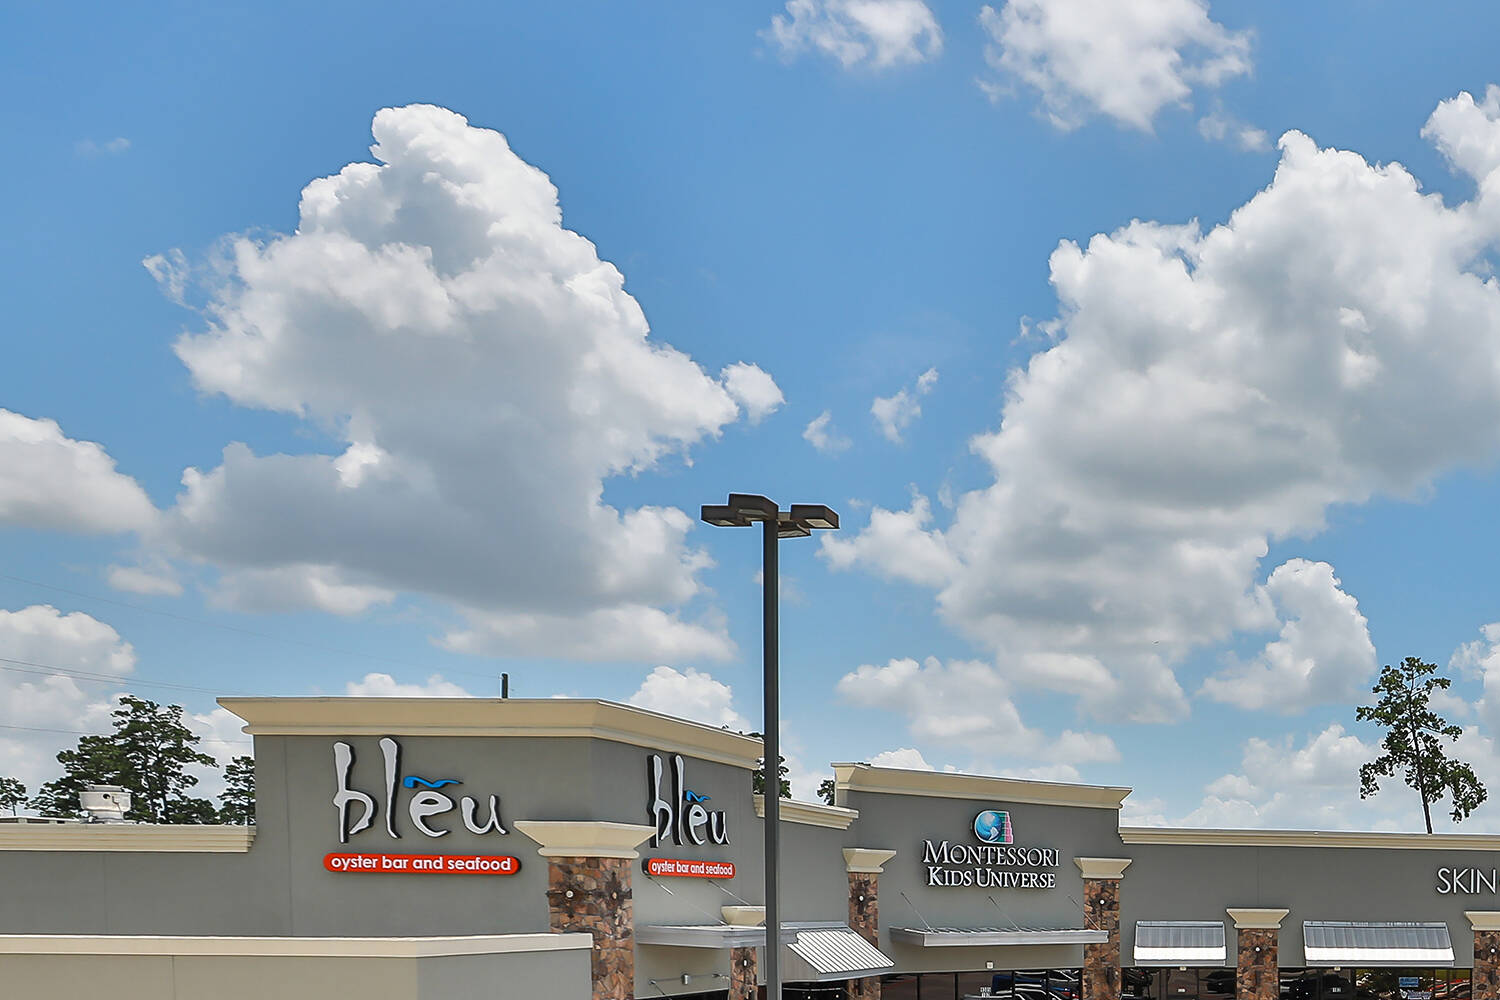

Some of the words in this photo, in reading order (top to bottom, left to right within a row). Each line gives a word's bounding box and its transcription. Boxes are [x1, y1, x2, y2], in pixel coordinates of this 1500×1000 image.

[331, 856, 378, 871] oyster
[382, 856, 408, 869] bar
[413, 857, 443, 870] and
[447, 857, 511, 871] seafood
[922, 840, 1060, 867] MONTESSORI
[651, 861, 675, 874] oyster
[676, 861, 689, 873] bar
[690, 862, 705, 874] and
[705, 863, 733, 875] seafood
[927, 866, 972, 886] KIDS
[974, 867, 1056, 888] UNIVERSE
[1436, 868, 1496, 894] SKIN
